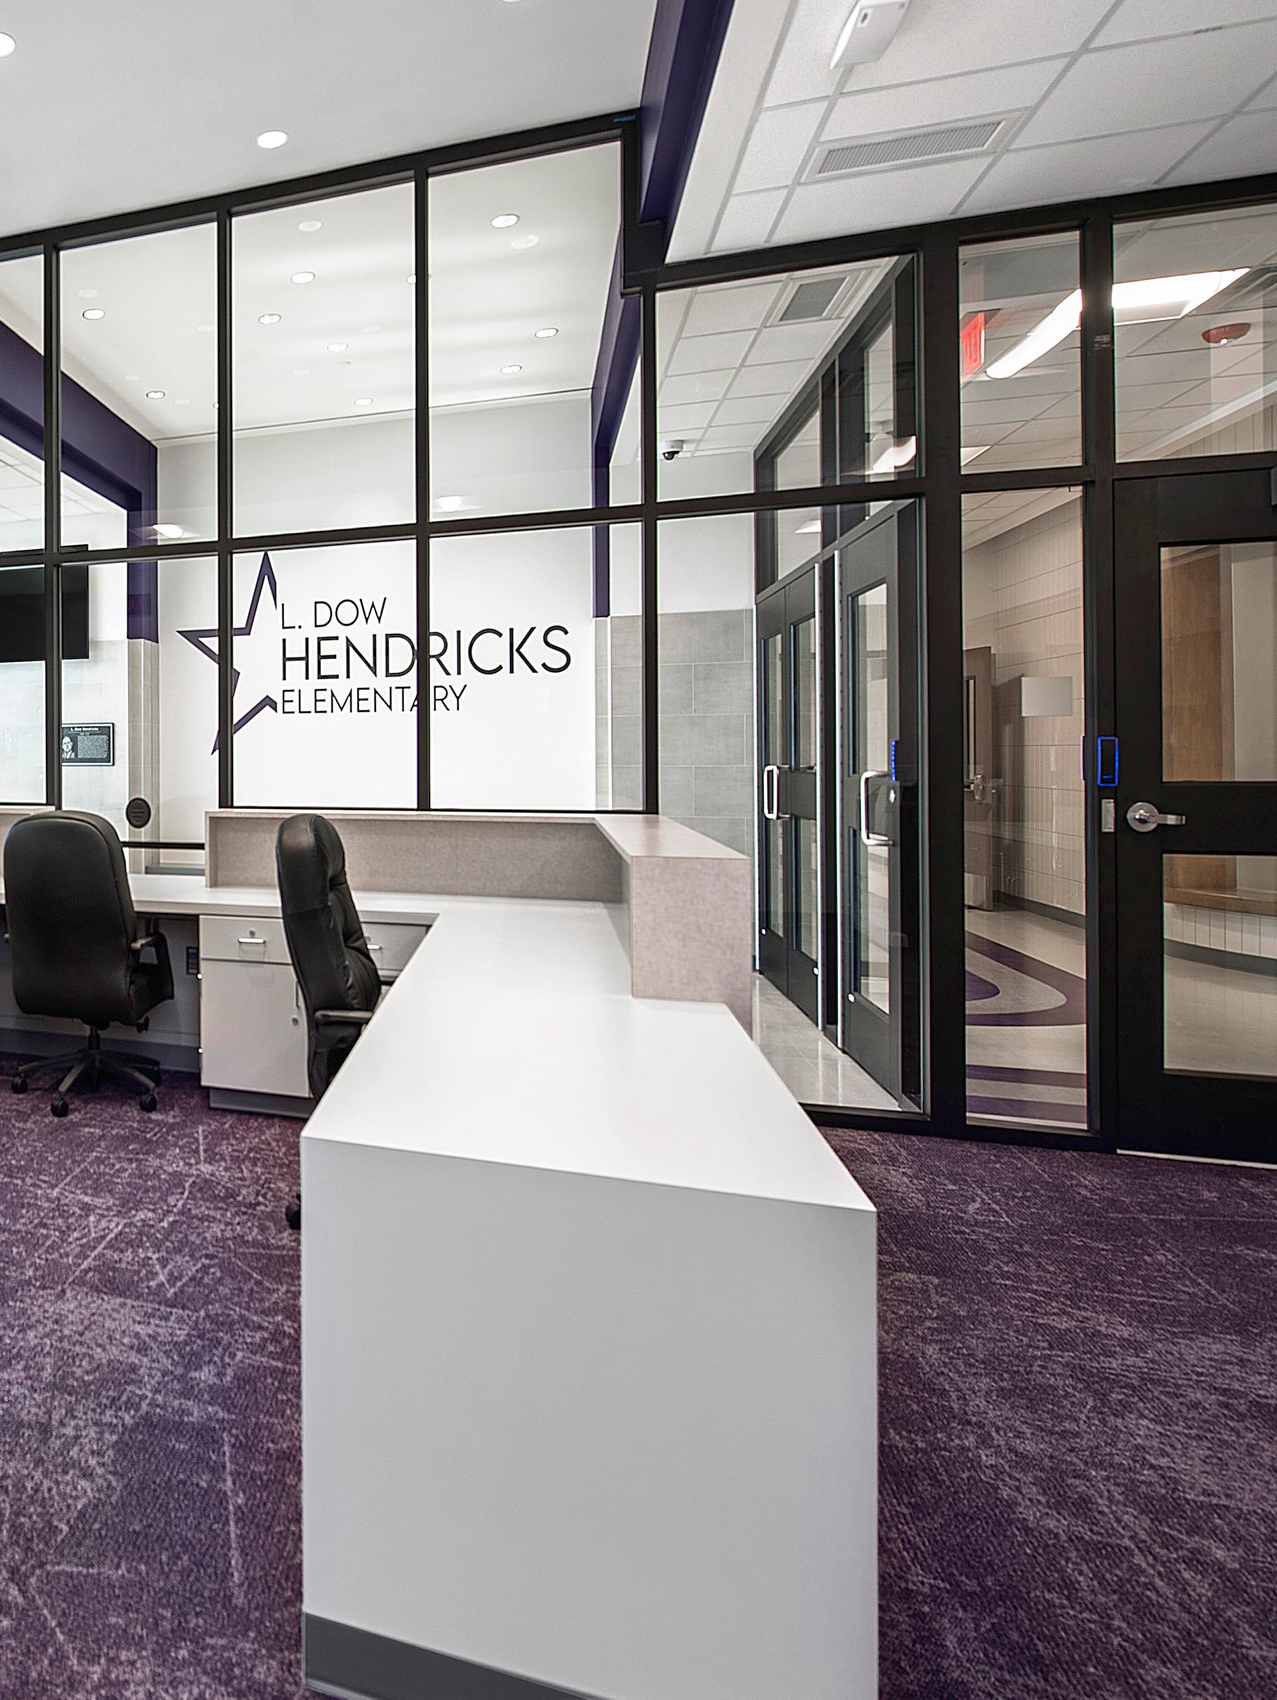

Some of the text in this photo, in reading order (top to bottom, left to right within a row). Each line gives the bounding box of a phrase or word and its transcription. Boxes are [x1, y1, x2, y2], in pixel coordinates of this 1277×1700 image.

[281, 596, 387, 630] L. DOW
[281, 625, 571, 681] HENDRICKS
